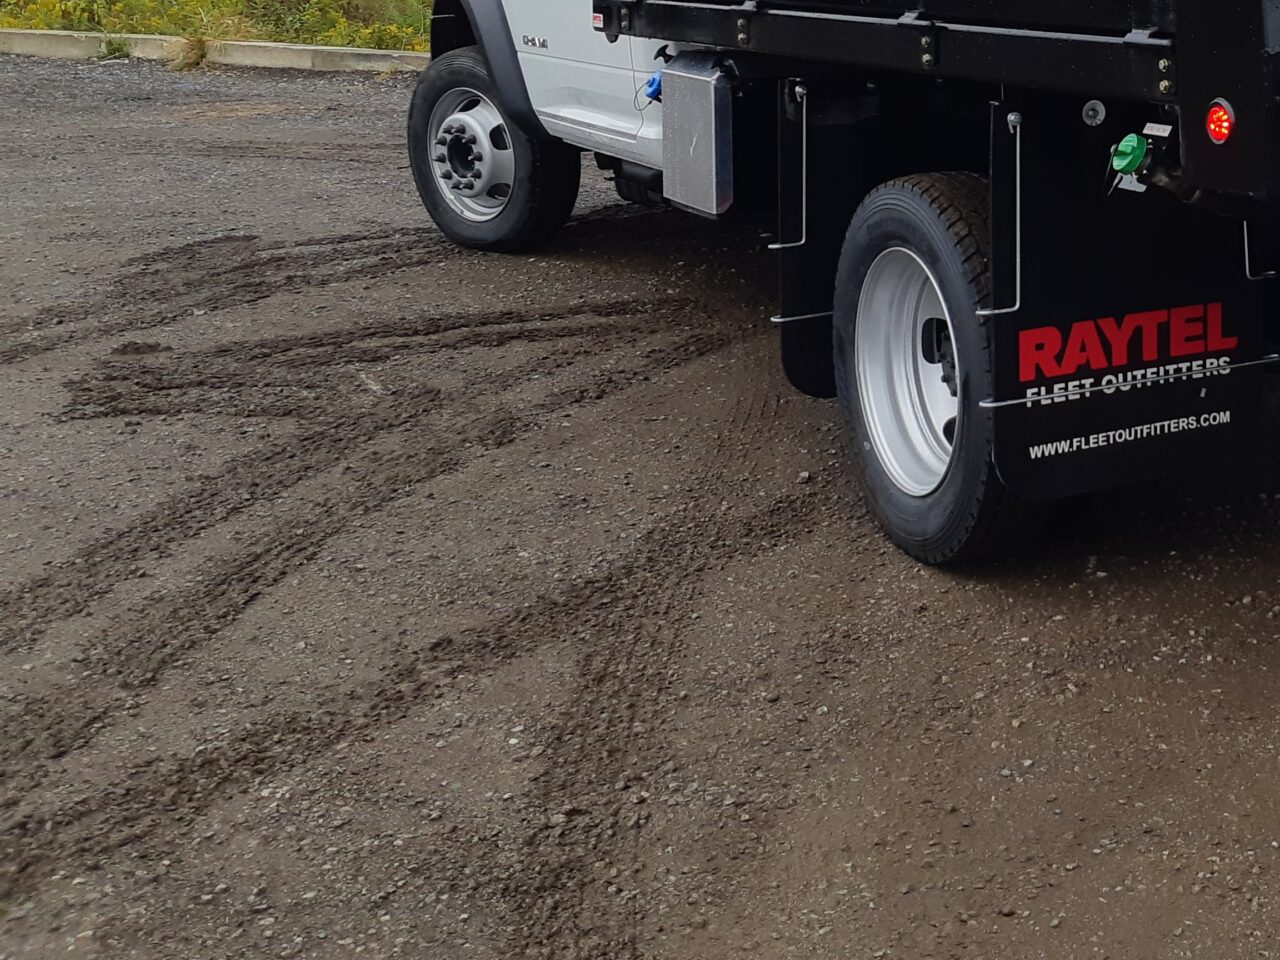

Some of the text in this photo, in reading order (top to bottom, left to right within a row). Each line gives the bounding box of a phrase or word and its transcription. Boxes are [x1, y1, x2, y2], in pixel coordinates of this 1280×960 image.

[1018, 302, 1239, 382] RAYTEL
[1026, 356, 1231, 407] FLEET OUTFITTERS
[1029, 410, 1231, 459] WWW.FLEETOUTFITTERS.COM
